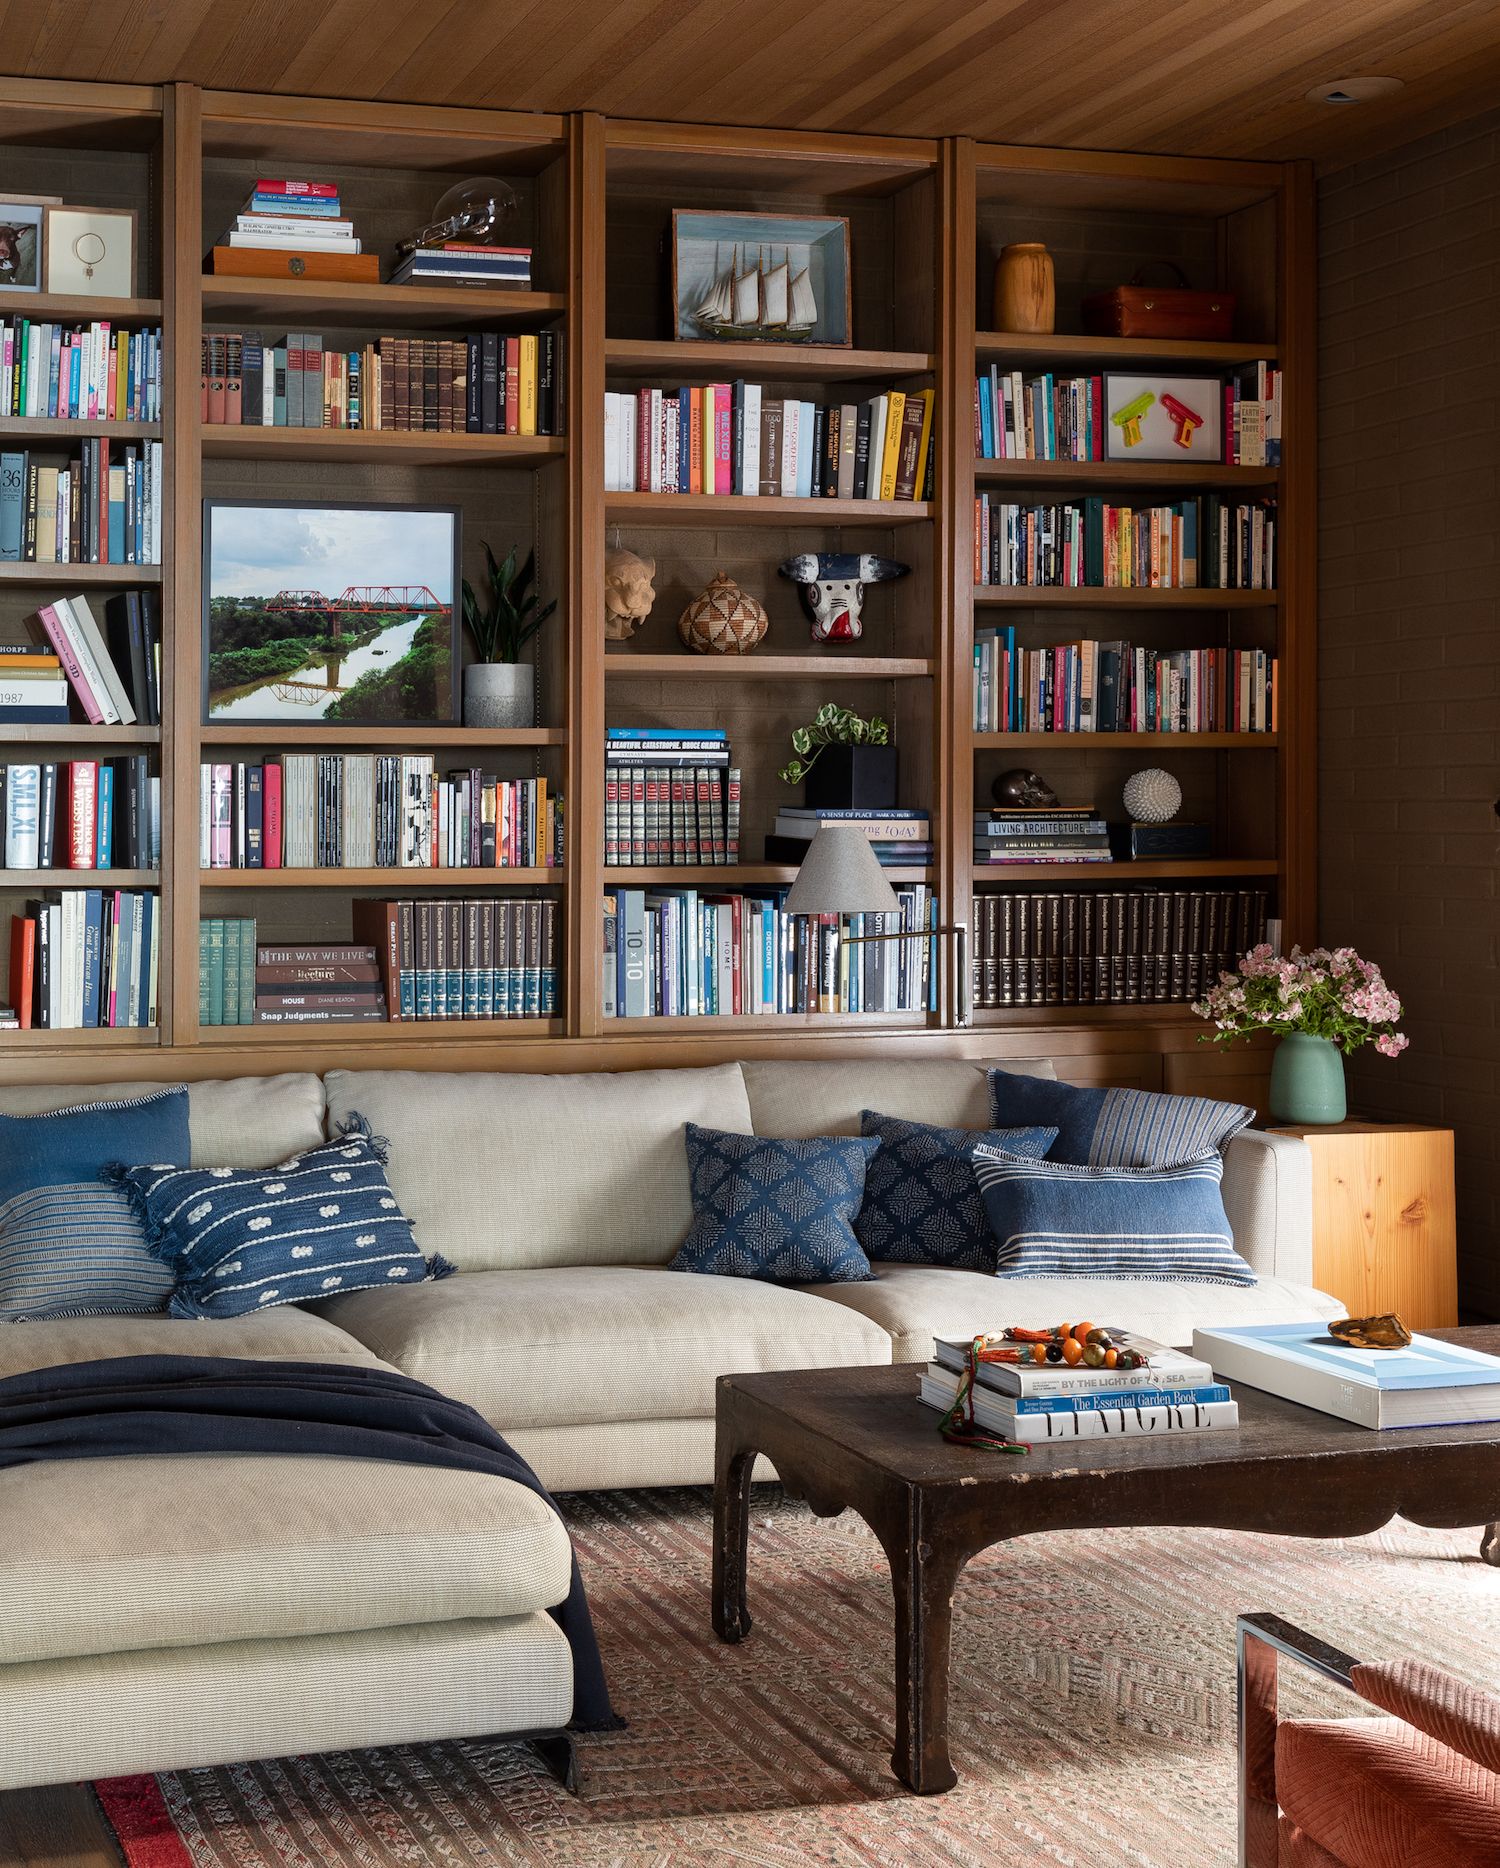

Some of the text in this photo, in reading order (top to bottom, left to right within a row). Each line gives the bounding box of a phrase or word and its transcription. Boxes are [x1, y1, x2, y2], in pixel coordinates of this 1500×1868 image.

[2, 469, 20, 487] 36
[69, 665, 80, 679] 3D
[0, 693, 23, 703] 1987
[73, 788, 83, 855] WEBSTER'S
[993, 824, 1084, 833] LIVING ARCHITECTURE
[40, 910, 49, 945] hyperwest
[86, 926, 94, 946] Great
[627, 929, 643, 948] 10
[85, 947, 94, 980] American
[270, 951, 365, 961] THE WAY WE LIVE
[627, 960, 643, 980] 10
[261, 1011, 329, 1021] Snap Judgments
[1061, 1380, 1075, 1389] BY
[1078, 1378, 1098, 1387] THE
[1099, 1378, 1128, 1387] LIGHT
[1130, 1377, 1143, 1385] OF
[1166, 1374, 1185, 1383] SEA
[1339, 1384, 1354, 1395] THE
[1072, 1391, 1197, 1411] The Essential Garden Book
